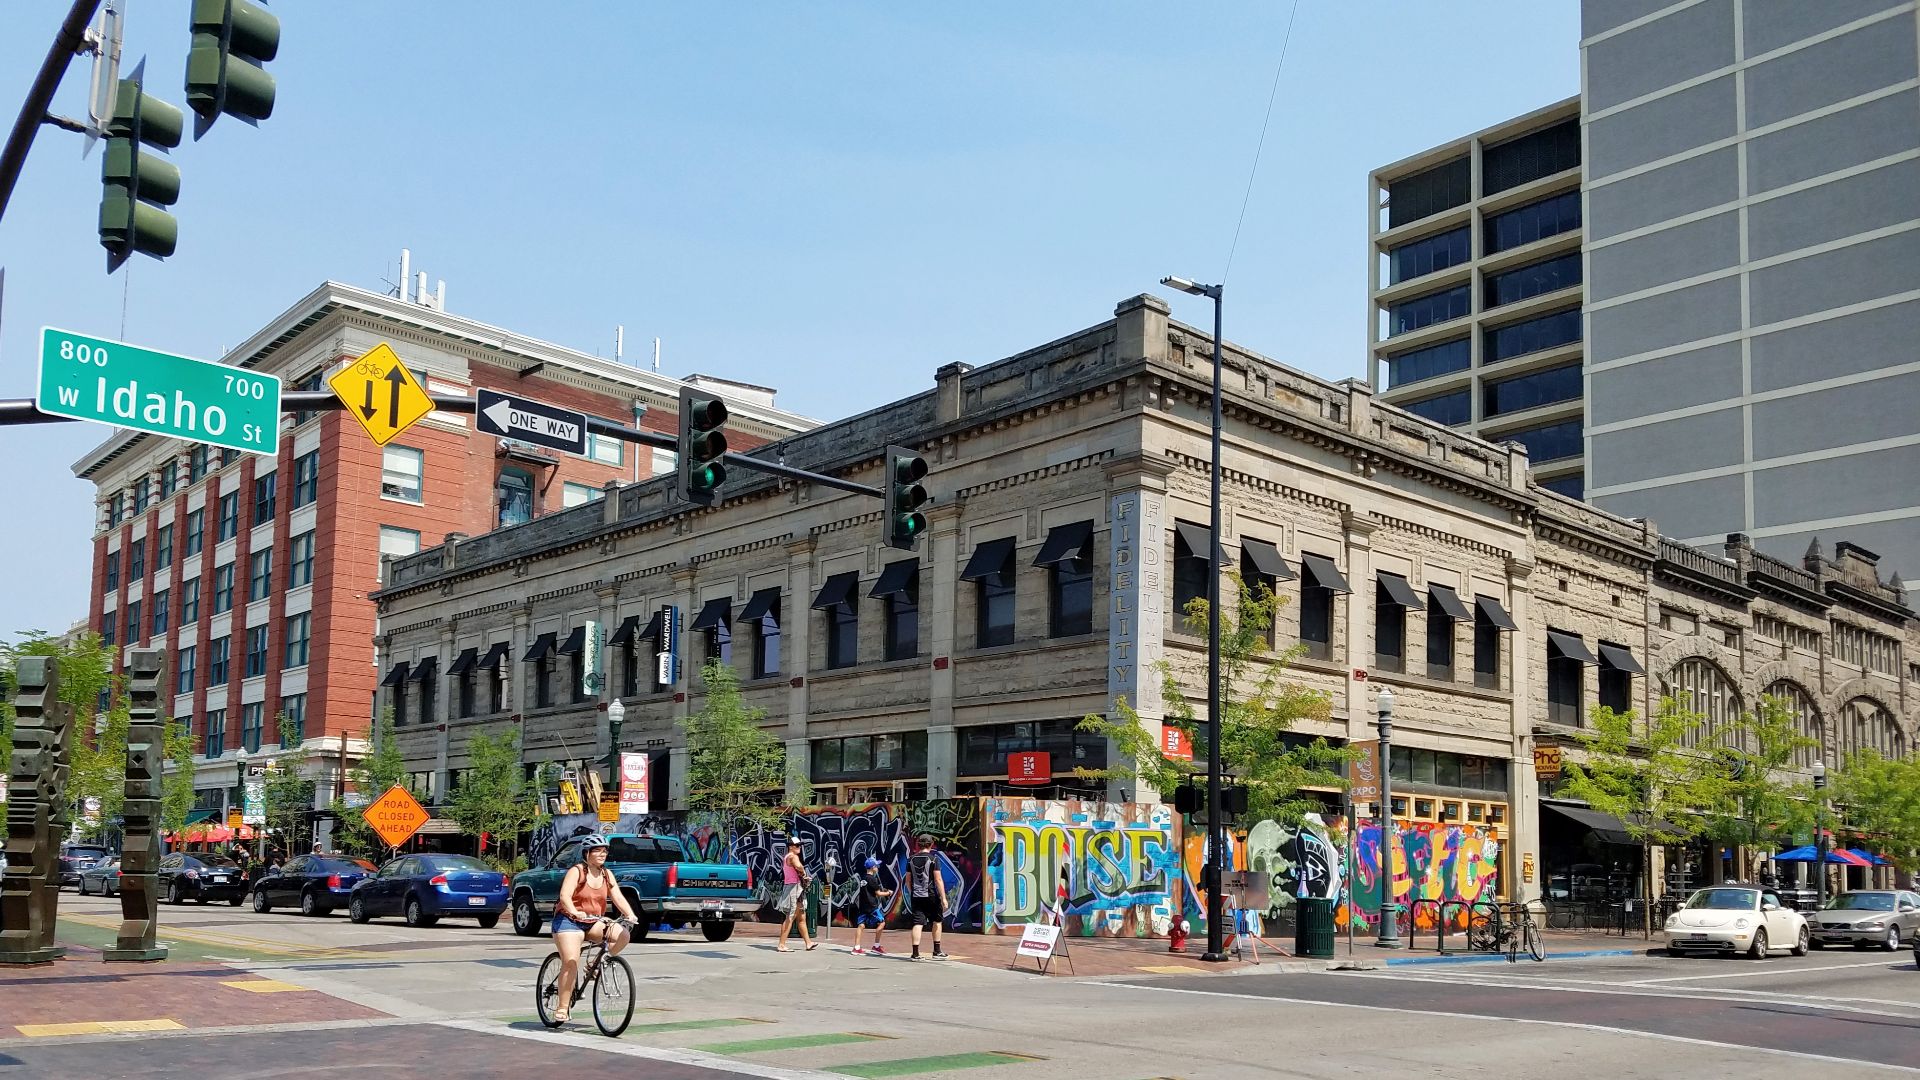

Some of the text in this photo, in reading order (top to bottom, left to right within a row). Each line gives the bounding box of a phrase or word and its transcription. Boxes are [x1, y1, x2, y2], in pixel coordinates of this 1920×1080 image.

[60, 341, 108, 367] 800
[224, 375, 264, 399] 700
[58, 377, 262, 444] W Idaho St
[510, 412, 574, 438] ONE WAY
[1113, 500, 1134, 683] FIDELITY
[1142, 500, 1160, 683] FIDELITY
[663, 608, 671, 651] WARDWELL
[251, 766, 286, 777] PRST
[1351, 786, 1377, 796] EXPO
[378, 812, 415, 821] CLOSED
[383, 800, 410, 809] ROAD
[380, 824, 412, 833] AHEAD
[682, 879, 744, 888] CHEVROLET
[992, 824, 1169, 928] BOISE
